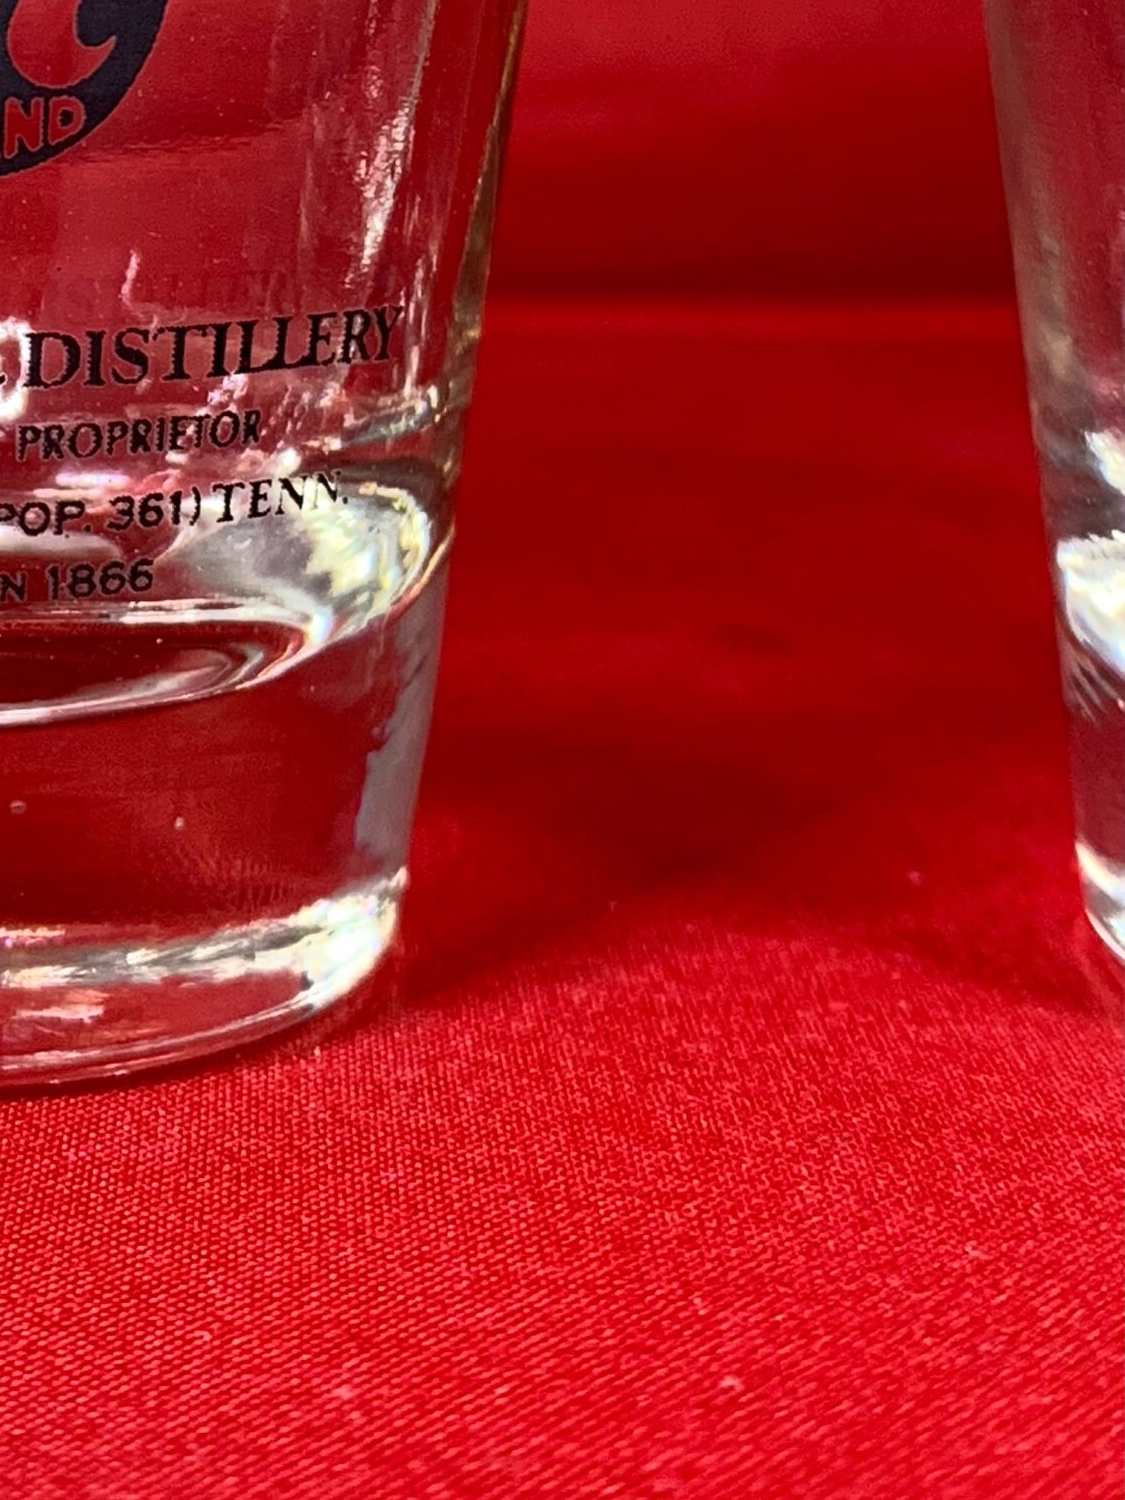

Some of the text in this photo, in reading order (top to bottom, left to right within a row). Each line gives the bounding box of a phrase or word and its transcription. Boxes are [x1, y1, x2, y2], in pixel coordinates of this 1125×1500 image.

[24, 304, 404, 390] DISTILLERY
[16, 408, 263, 462] PROPRIETOR
[106, 486, 202, 533] 361)
[212, 470, 350, 524] TENN.
[45, 557, 155, 600] 1866
